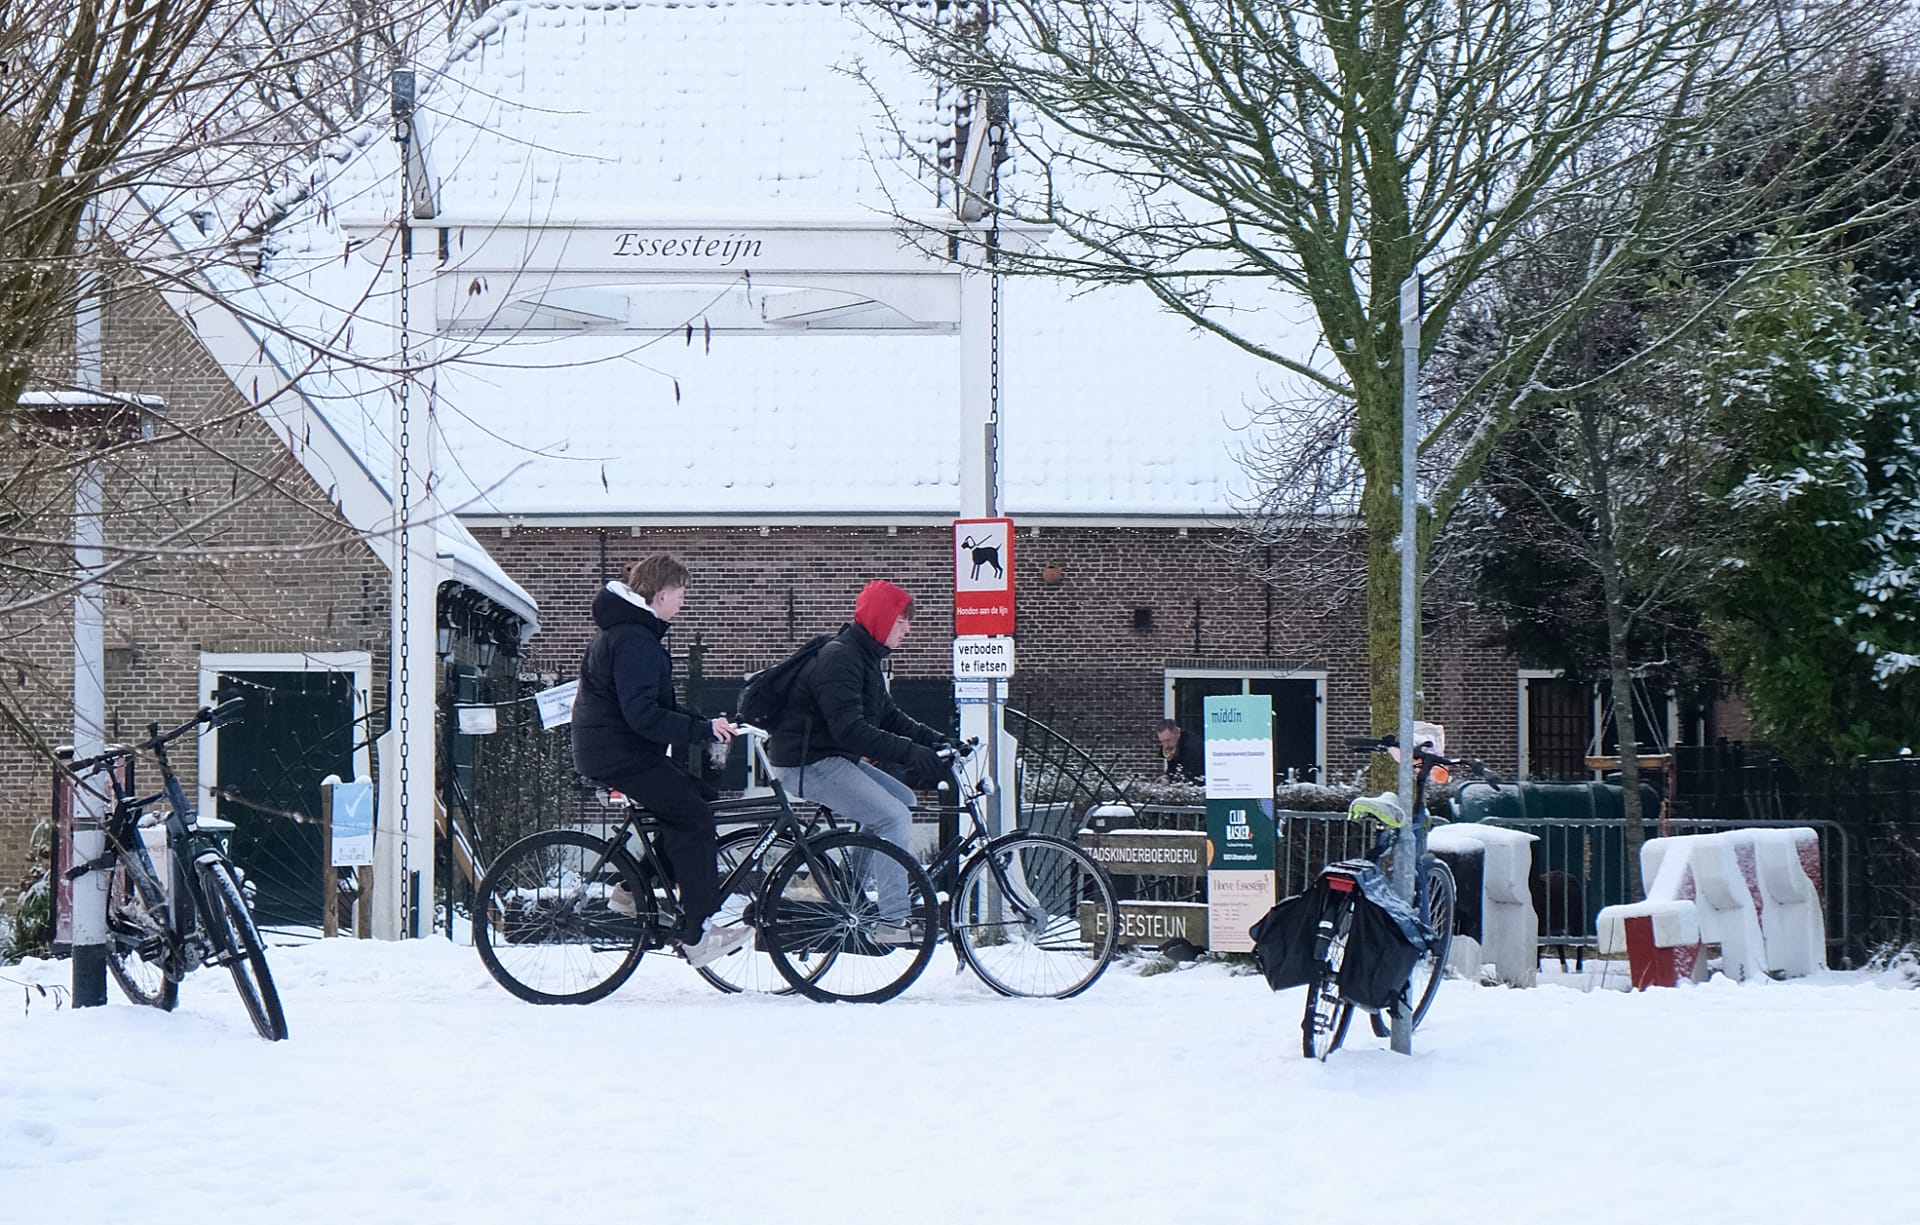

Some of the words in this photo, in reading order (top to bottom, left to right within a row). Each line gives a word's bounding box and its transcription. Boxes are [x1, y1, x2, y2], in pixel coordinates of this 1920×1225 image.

[613, 233, 762, 266] Essesteijn
[956, 606, 979, 615] Honden
[979, 607, 990, 615] aan
[991, 606, 998, 614] de
[999, 605, 1008, 616] lijn
[958, 643, 1004, 655] verboden
[961, 660, 971, 672] te
[973, 660, 1007, 672] fietsen
[1211, 707, 1242, 723] middin
[1096, 912, 1187, 938] ESESTEIJN
